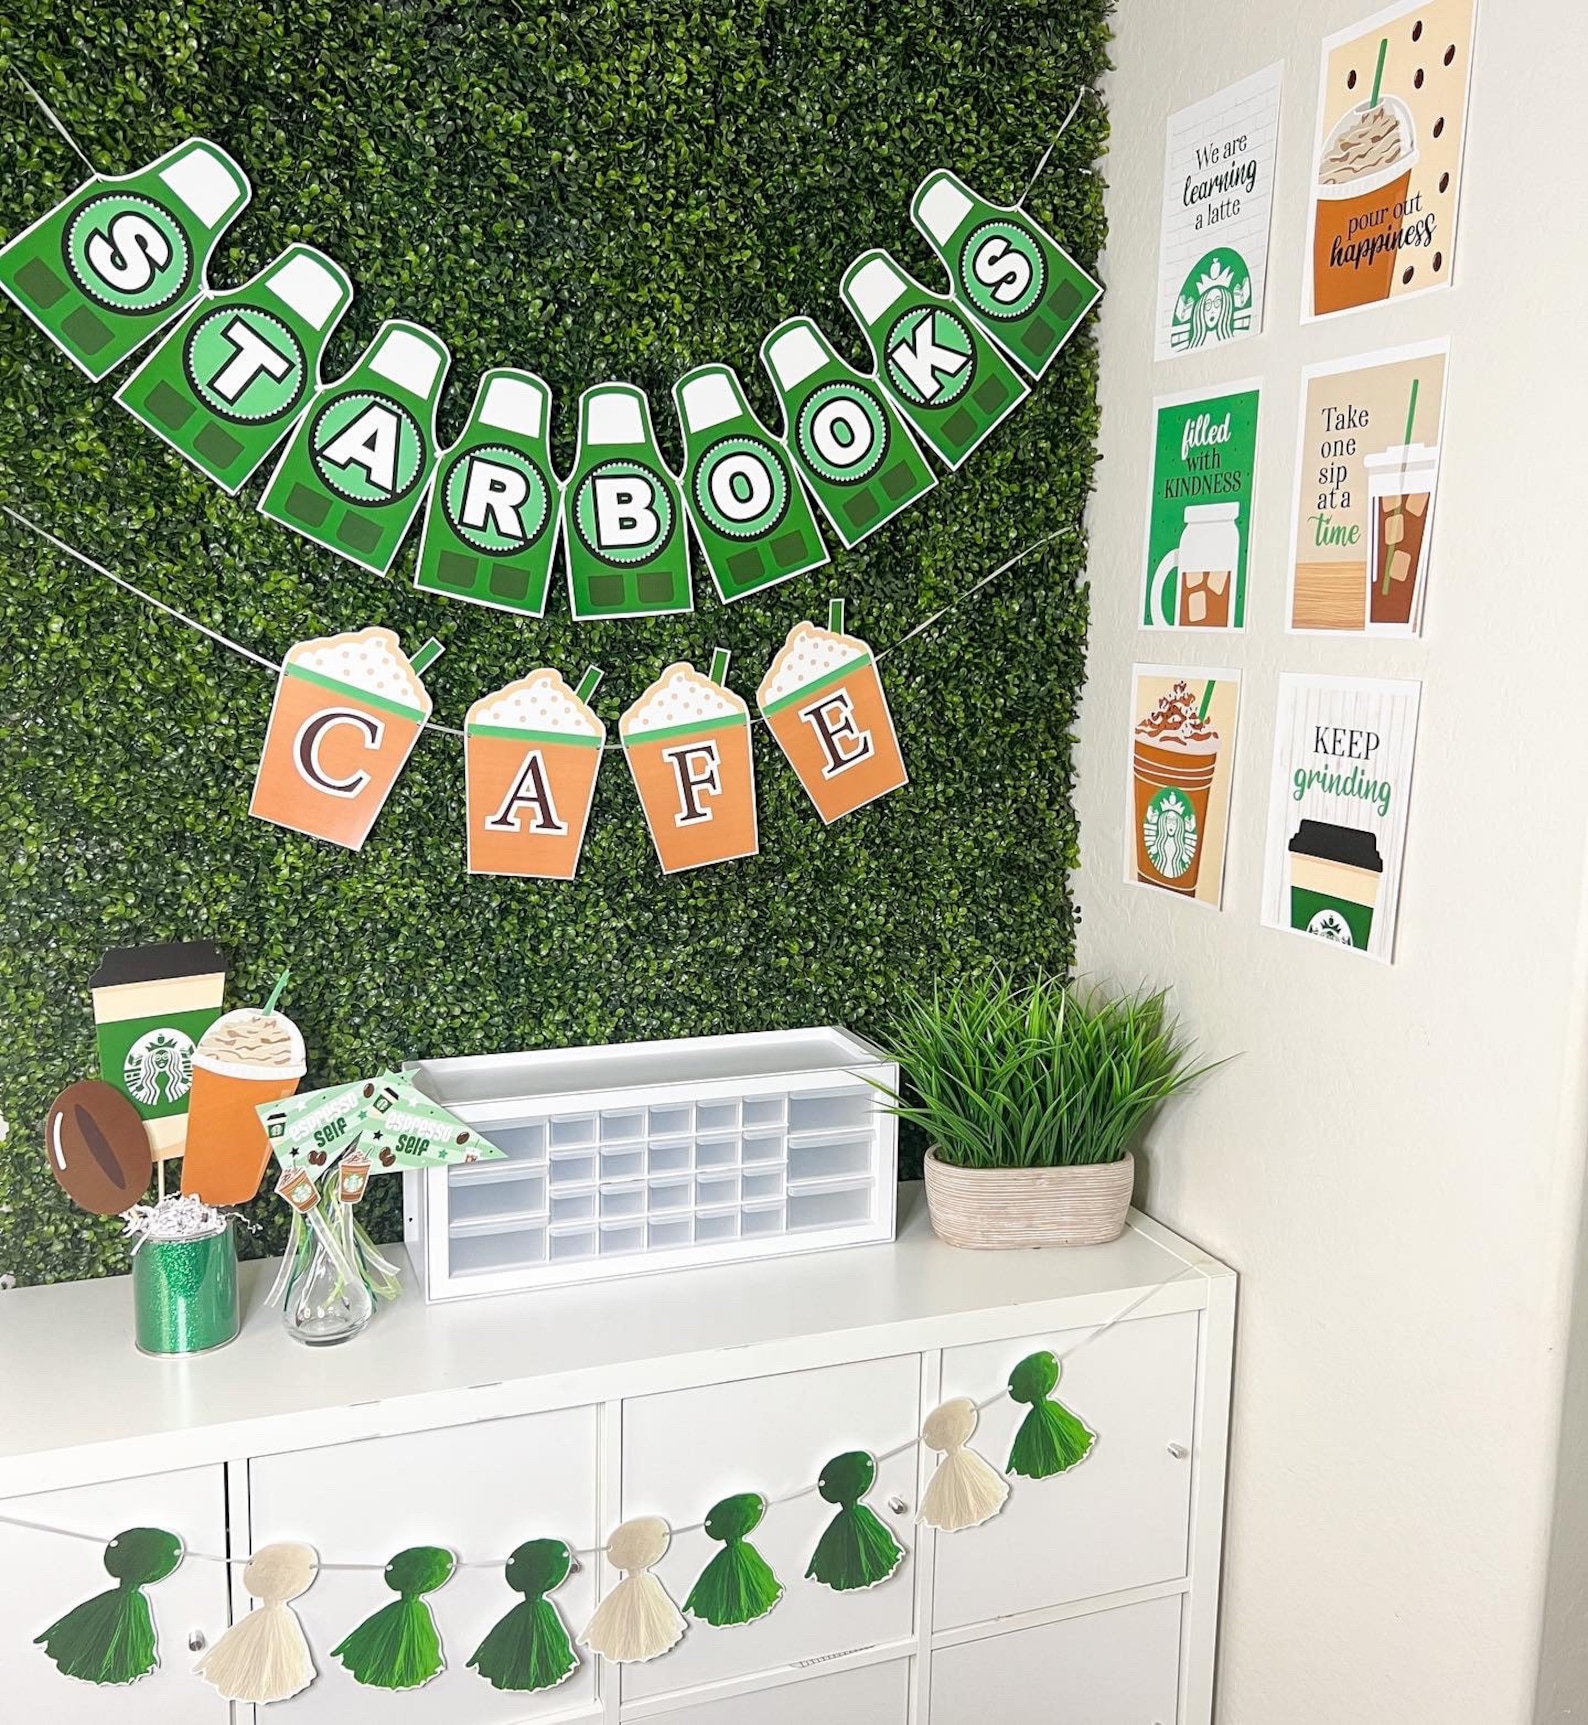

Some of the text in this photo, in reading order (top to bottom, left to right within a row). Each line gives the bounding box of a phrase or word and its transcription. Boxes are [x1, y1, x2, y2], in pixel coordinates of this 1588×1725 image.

[1196, 134, 1247, 170] We are
[1183, 159, 1257, 206] learning
[1195, 197, 1240, 230] a latte
[1348, 192, 1422, 240] pour out
[1330, 213, 1437, 269] happiness
[1322, 404, 1369, 431] Take
[1181, 413, 1231, 461] filled
[1321, 437, 1356, 459] one
[1187, 448, 1221, 472] with
[1318, 462, 1347, 490] sip
[1165, 472, 1241, 498] KINDNESS
[1317, 487, 1351, 509] at a
[1307, 513, 1361, 546] time
[1313, 726, 1379, 760] KEEP
[1293, 762, 1391, 817] grinding
[314, 1117, 347, 1148] self
[396, 1134, 429, 1157] self
